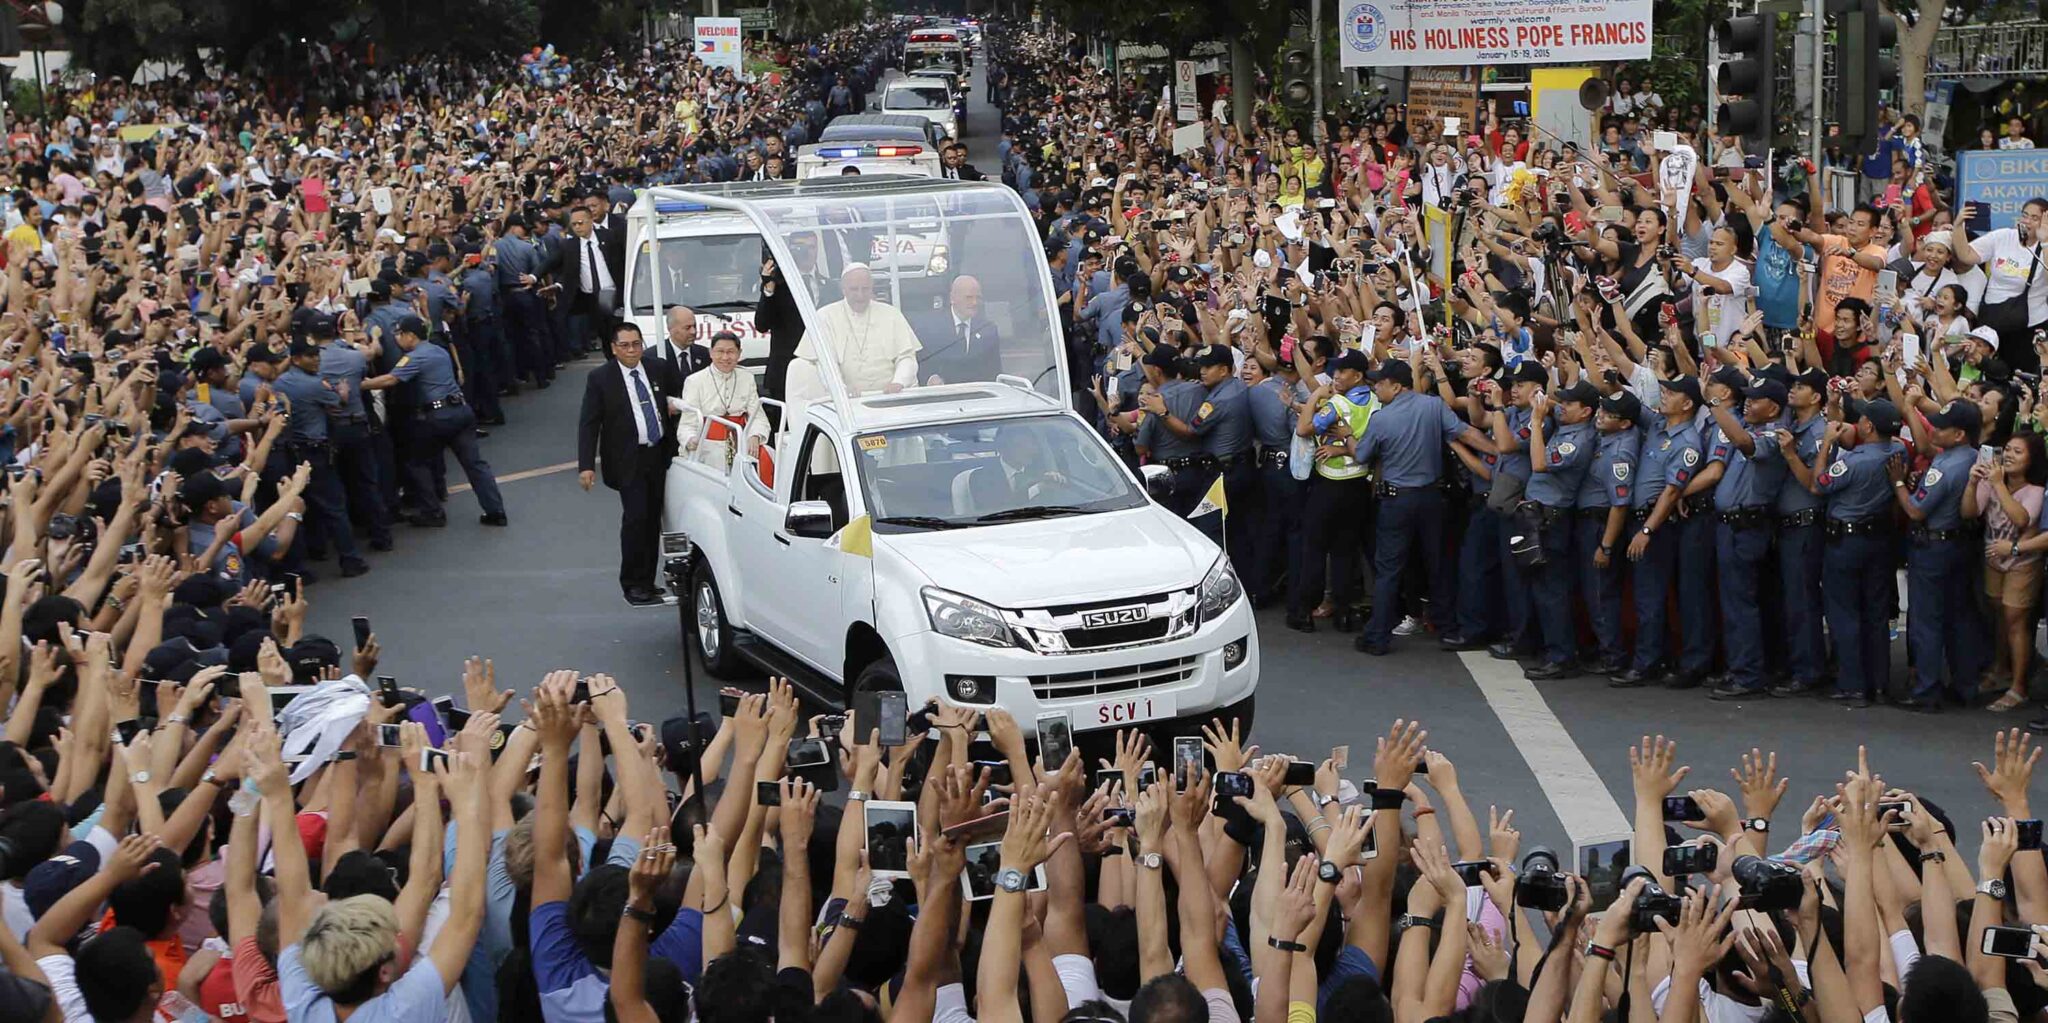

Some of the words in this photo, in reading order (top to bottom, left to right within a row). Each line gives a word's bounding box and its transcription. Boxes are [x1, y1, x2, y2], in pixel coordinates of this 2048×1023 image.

[1513, 7, 1544, 15] Cultural
[1470, 17, 1504, 25] warmly
[1508, 15, 1551, 23] welcome
[697, 26, 738, 37] WELCOME
[1389, 29, 1417, 51] HIS
[1424, 26, 1509, 50] HOLINESS
[1516, 24, 1564, 47] POPE
[1570, 21, 1646, 46] FRANCIS
[1476, 51, 1508, 60] January
[1534, 49, 1550, 58] 2015
[1983, 185, 2046, 198] AKAYIN
[1085, 608, 1147, 626] ISUZU
[1099, 702, 1136, 723] SCV
[1146, 700, 1152, 718] 1
